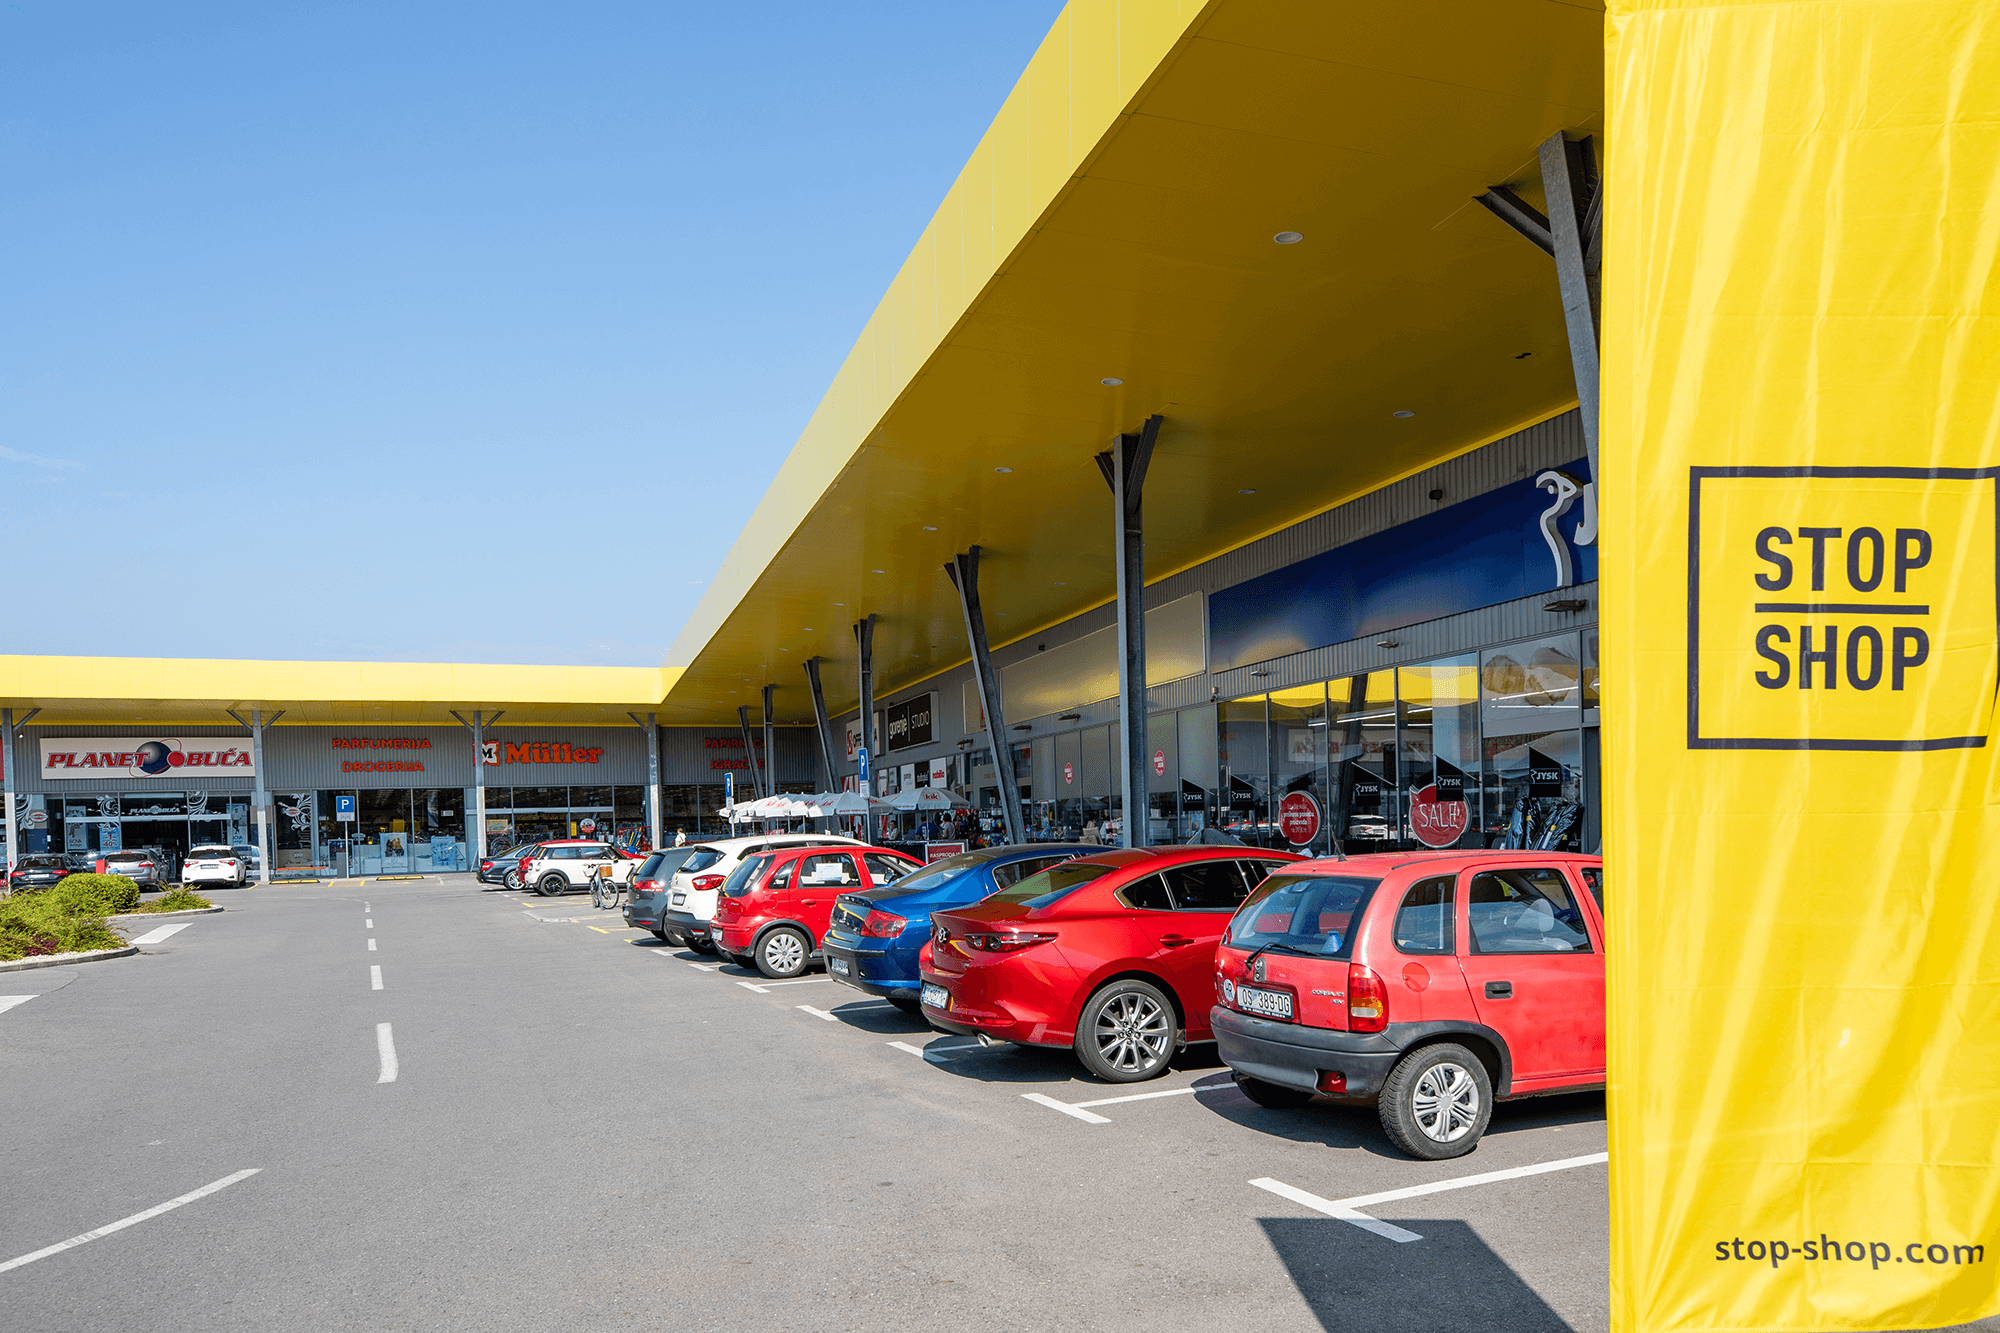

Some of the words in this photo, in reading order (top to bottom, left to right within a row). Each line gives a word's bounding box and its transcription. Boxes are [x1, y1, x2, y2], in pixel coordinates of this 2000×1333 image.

[1754, 526, 1932, 593] STOP
[1754, 623, 1930, 691] SHOP
[888, 713, 908, 740] gorenje
[911, 710, 930, 729] STUDIO
[332, 738, 432, 749] PARFUMERIJA
[704, 739, 766, 749] PAPIRNC
[504, 742, 603, 764] Müller
[45, 752, 150, 769] PLANET
[342, 761, 425, 772] DROGERIJA
[710, 757, 765, 770] IGRAČE
[1442, 778, 1461, 786] JYSK
[1536, 771, 1559, 780] JYSK
[1360, 785, 1378, 793] JYSK
[341, 799, 350, 810] P
[1418, 802, 1459, 829] SALE
[1312, 989, 1334, 997] CORSA
[1242, 988, 1253, 1006] OS
[1258, 991, 1290, 1013] 389-DG
[1715, 1233, 1984, 1270] stop-shop.com
